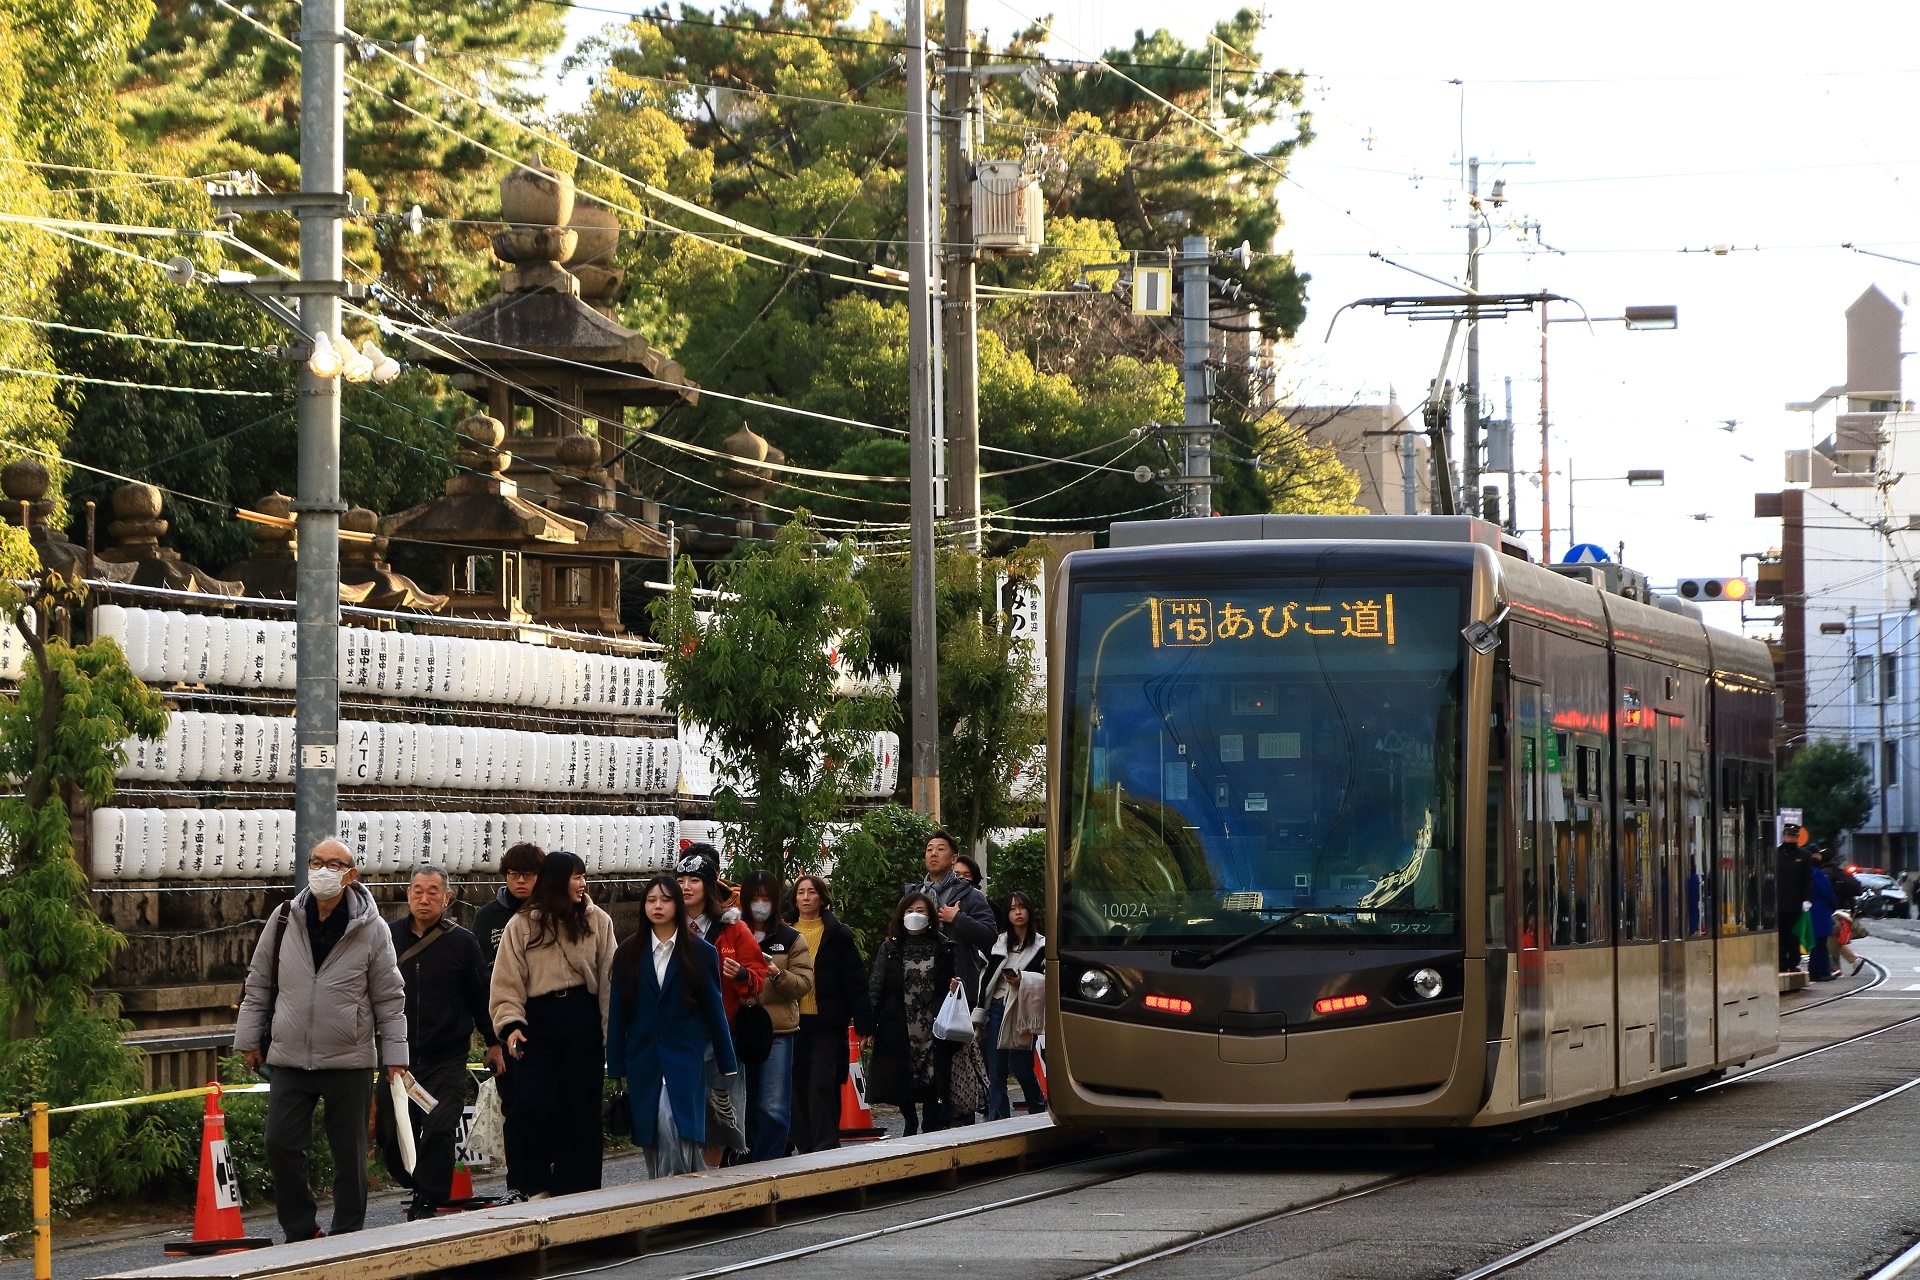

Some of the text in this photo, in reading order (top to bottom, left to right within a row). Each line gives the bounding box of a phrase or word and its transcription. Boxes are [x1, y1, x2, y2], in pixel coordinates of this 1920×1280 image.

[1171, 603, 1201, 615] HN
[1217, 600, 1383, 640] あびこ道
[1168, 617, 1208, 642] 15
[320, 750, 328, 763] 5
[357, 731, 369, 778] ATC
[1102, 902, 1149, 918] 1002A
[1390, 923, 1431, 933] ワンマン
